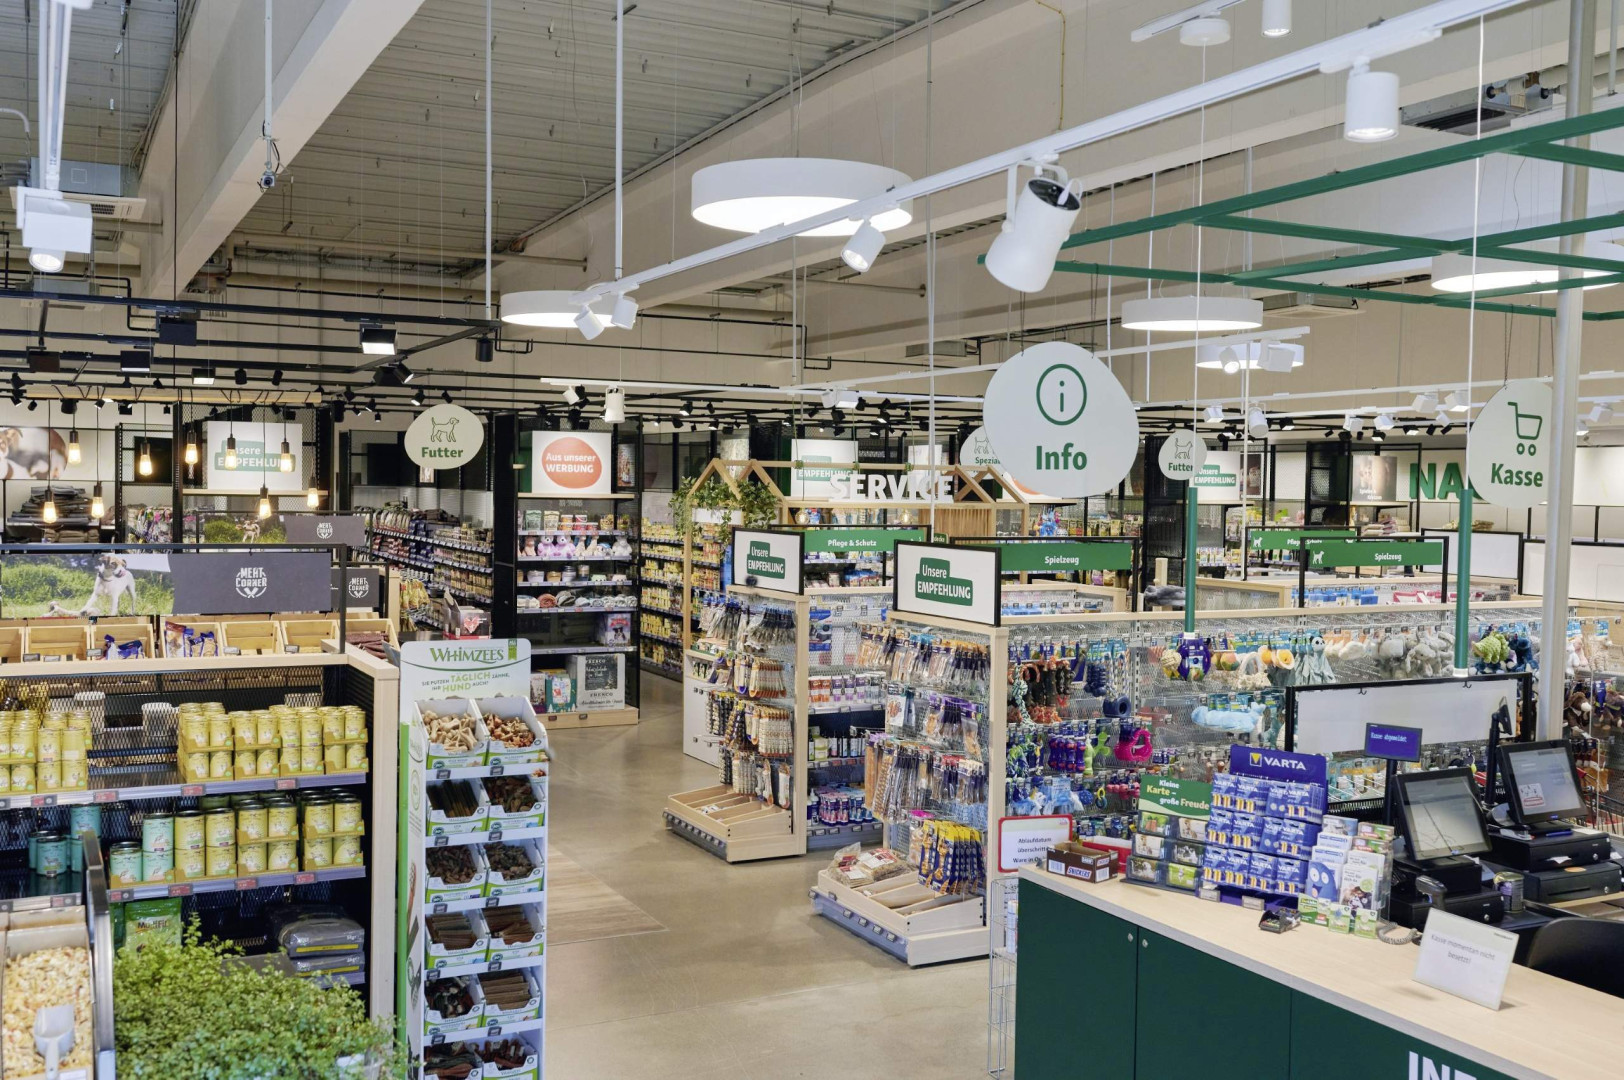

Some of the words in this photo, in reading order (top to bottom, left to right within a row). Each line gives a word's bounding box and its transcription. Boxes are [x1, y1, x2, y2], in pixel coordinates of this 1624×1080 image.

[421, 446, 463, 458] Futter
[546, 453, 561, 462] Aus
[1036, 442, 1087, 470] Info
[546, 464, 594, 473] WERBUNG
[1194, 476, 1236, 484] EMPFEHLUNG
[1490, 462, 1543, 488] Kasse
[830, 473, 953, 500] SERVICE
[827, 539, 848, 548] Pflege
[855, 539, 877, 547] Schutz
[1287, 538, 1300, 546] Pfleg
[751, 546, 768, 558] Unsere
[1374, 552, 1402, 562] Spielzeug
[1044, 555, 1080, 566] Spielzeug
[747, 560, 784, 574] EMPFEHLUNG
[922, 564, 947, 578] Unsere
[235, 577, 268, 587] CORNER
[917, 580, 971, 599] EMPFEHLUNG
[442, 683, 471, 692] HUND
[1263, 756, 1306, 770] VARTA
[1146, 784, 1170, 796] Karte
[1159, 780, 1180, 788] Kleine
[1159, 797, 1180, 806] große
[1180, 798, 1210, 810] Freude
[1068, 867, 1090, 878] SNICKERS
[1447, 940, 1479, 955] momentan
[1480, 950, 1495, 961] nicht
